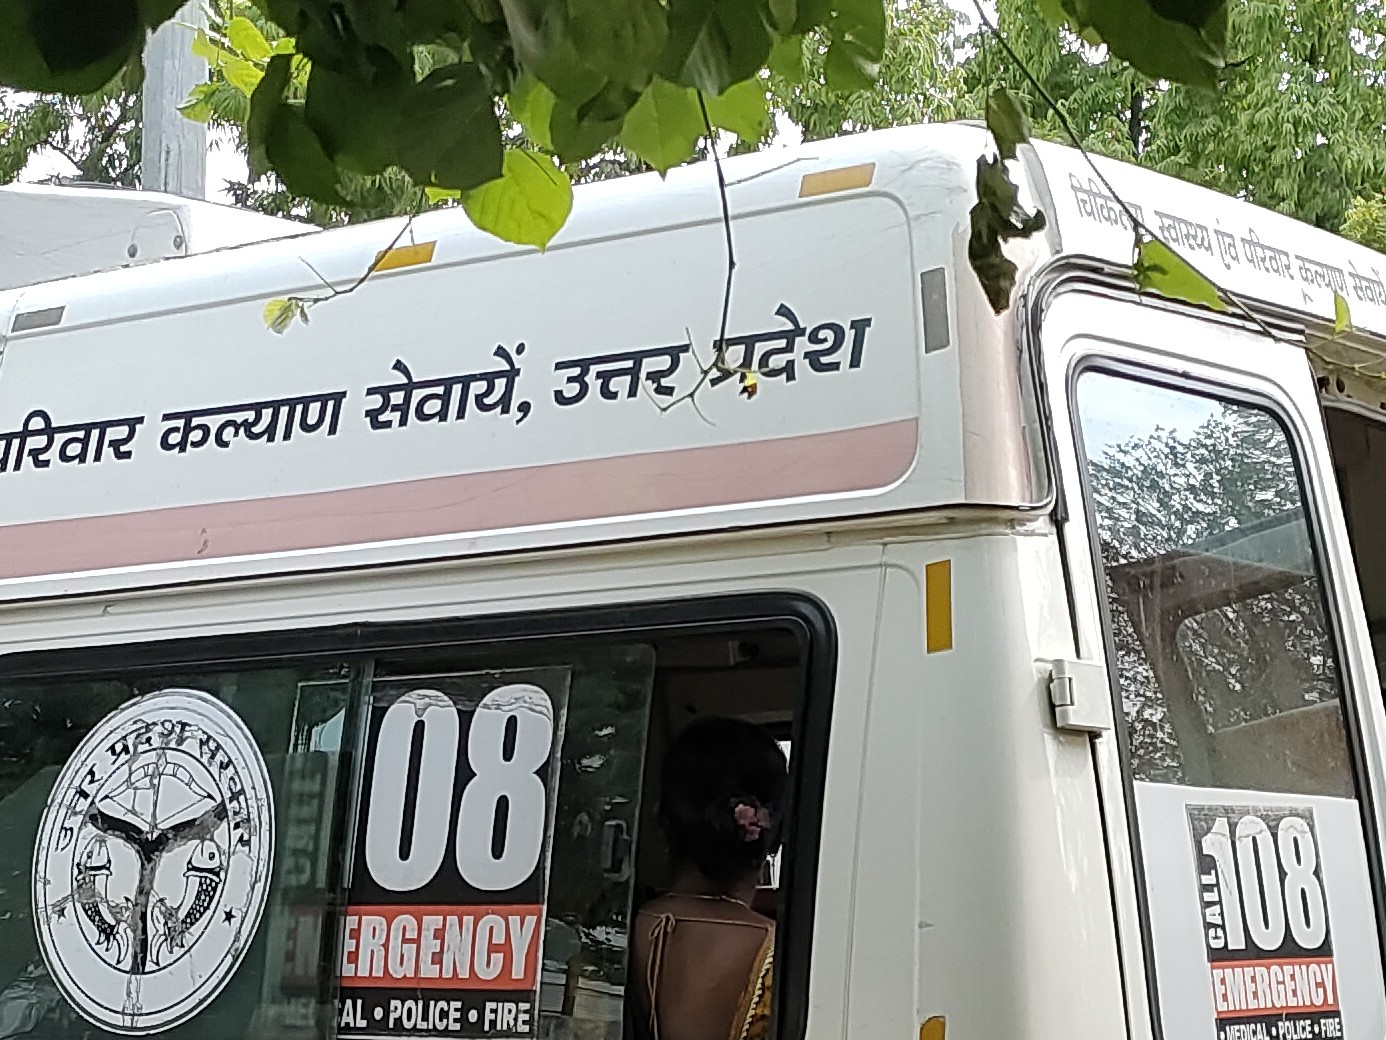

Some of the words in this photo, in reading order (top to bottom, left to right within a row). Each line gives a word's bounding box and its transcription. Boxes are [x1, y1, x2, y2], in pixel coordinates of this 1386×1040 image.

[1241, 227, 1294, 280] परिवार
[1294, 254, 1349, 296] कल्याण
[160, 390, 347, 454] कल्याण
[364, 343, 532, 431] सेवायें,
[554, 344, 692, 407] उत्तर
[710, 303, 872, 388] प्रदेश
[1200, 869, 1226, 949] CALL
[1201, 815, 1327, 951] 108
[388, 999, 462, 1032] POLICE
[484, 1002, 532, 1034] FIRE
[1212, 963, 1336, 1012] EMERGENCY
[1320, 1017, 1342, 1038] FIRE
